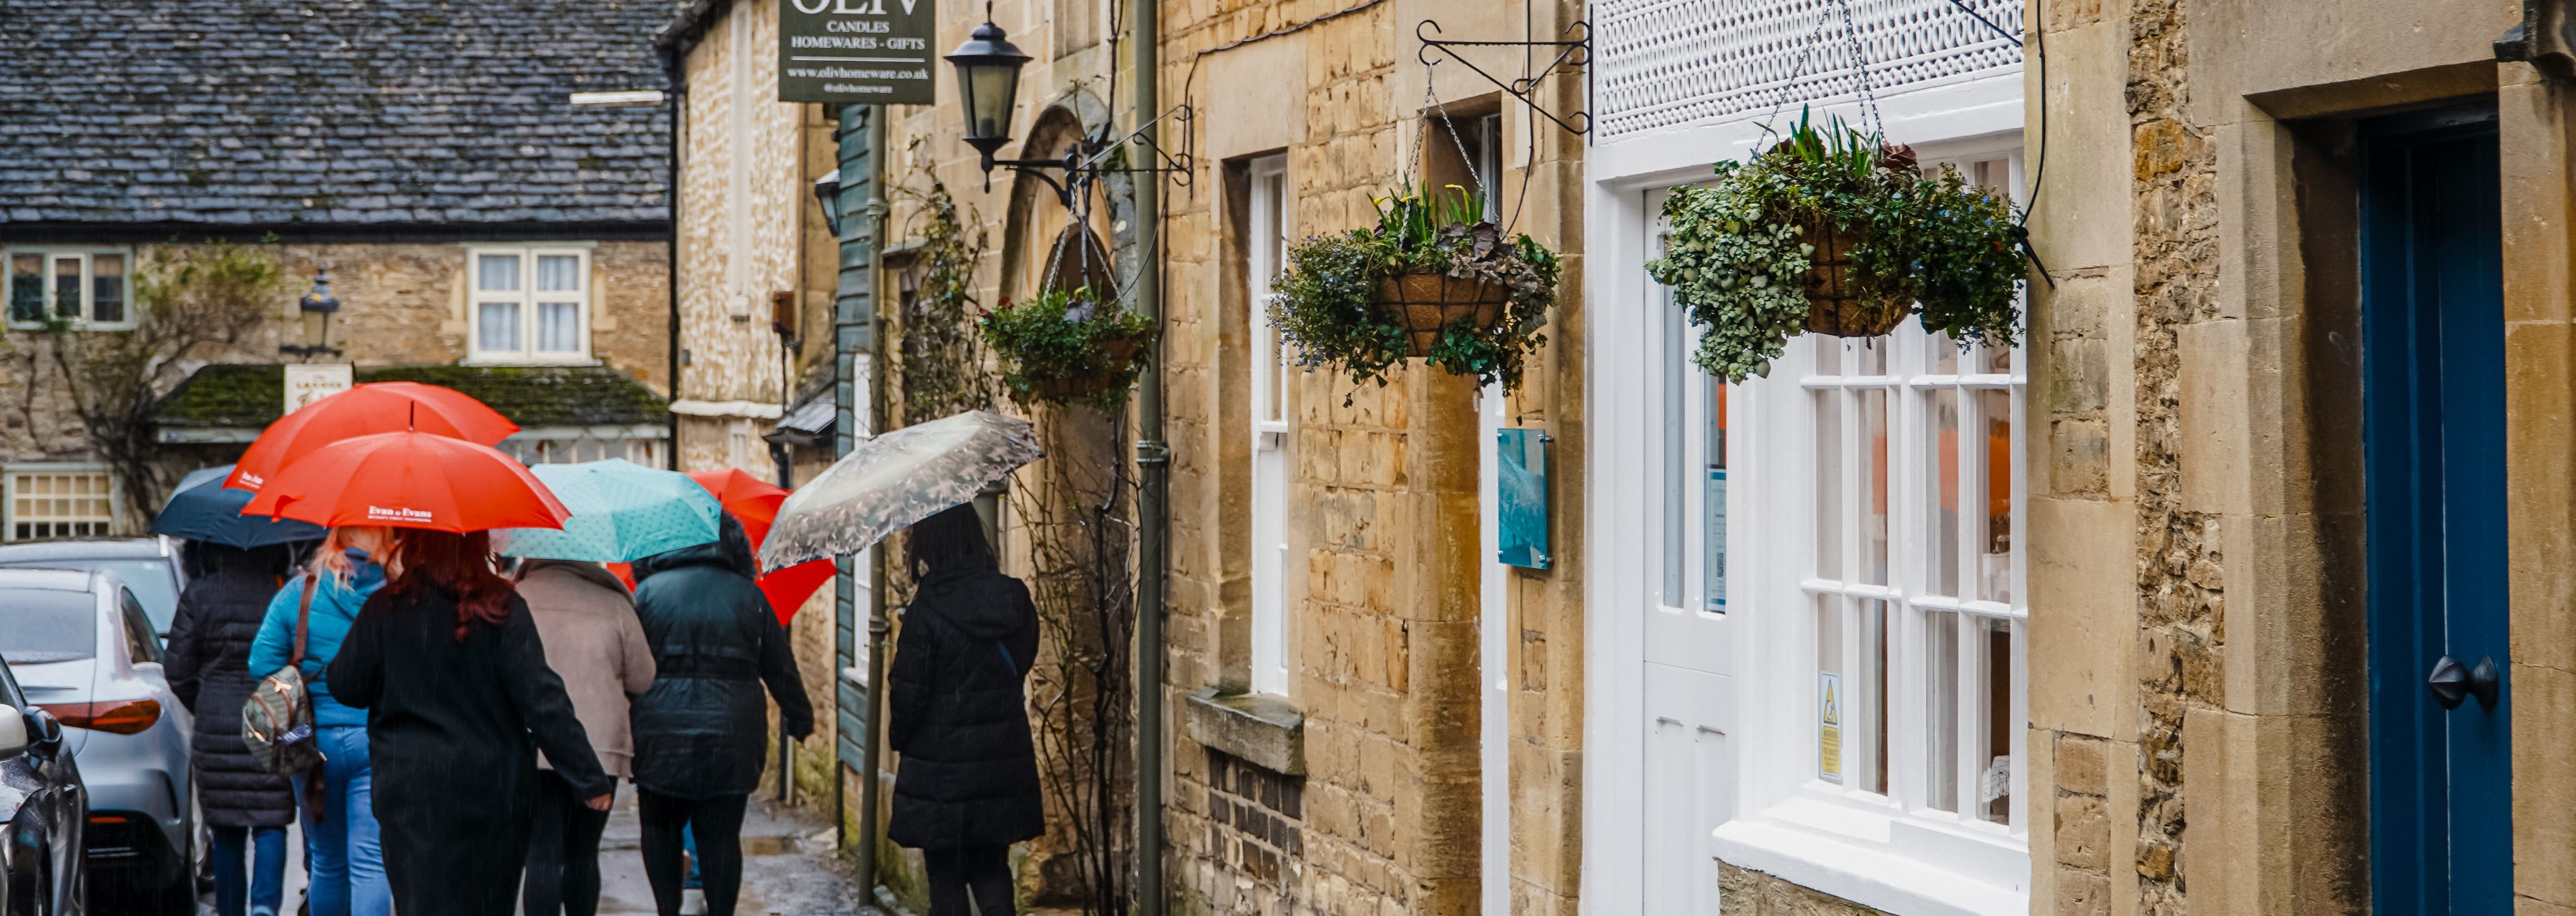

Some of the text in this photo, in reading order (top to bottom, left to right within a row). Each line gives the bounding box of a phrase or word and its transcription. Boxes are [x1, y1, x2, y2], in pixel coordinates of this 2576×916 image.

[826, 20, 890, 33] CANDLES
[791, 36, 877, 49] HOMEWARES
[886, 38, 926, 50] GIFTS
[787, 67, 929, 79] www.olivhomeware.co.uk
[824, 83, 893, 94] @olivhomeware
